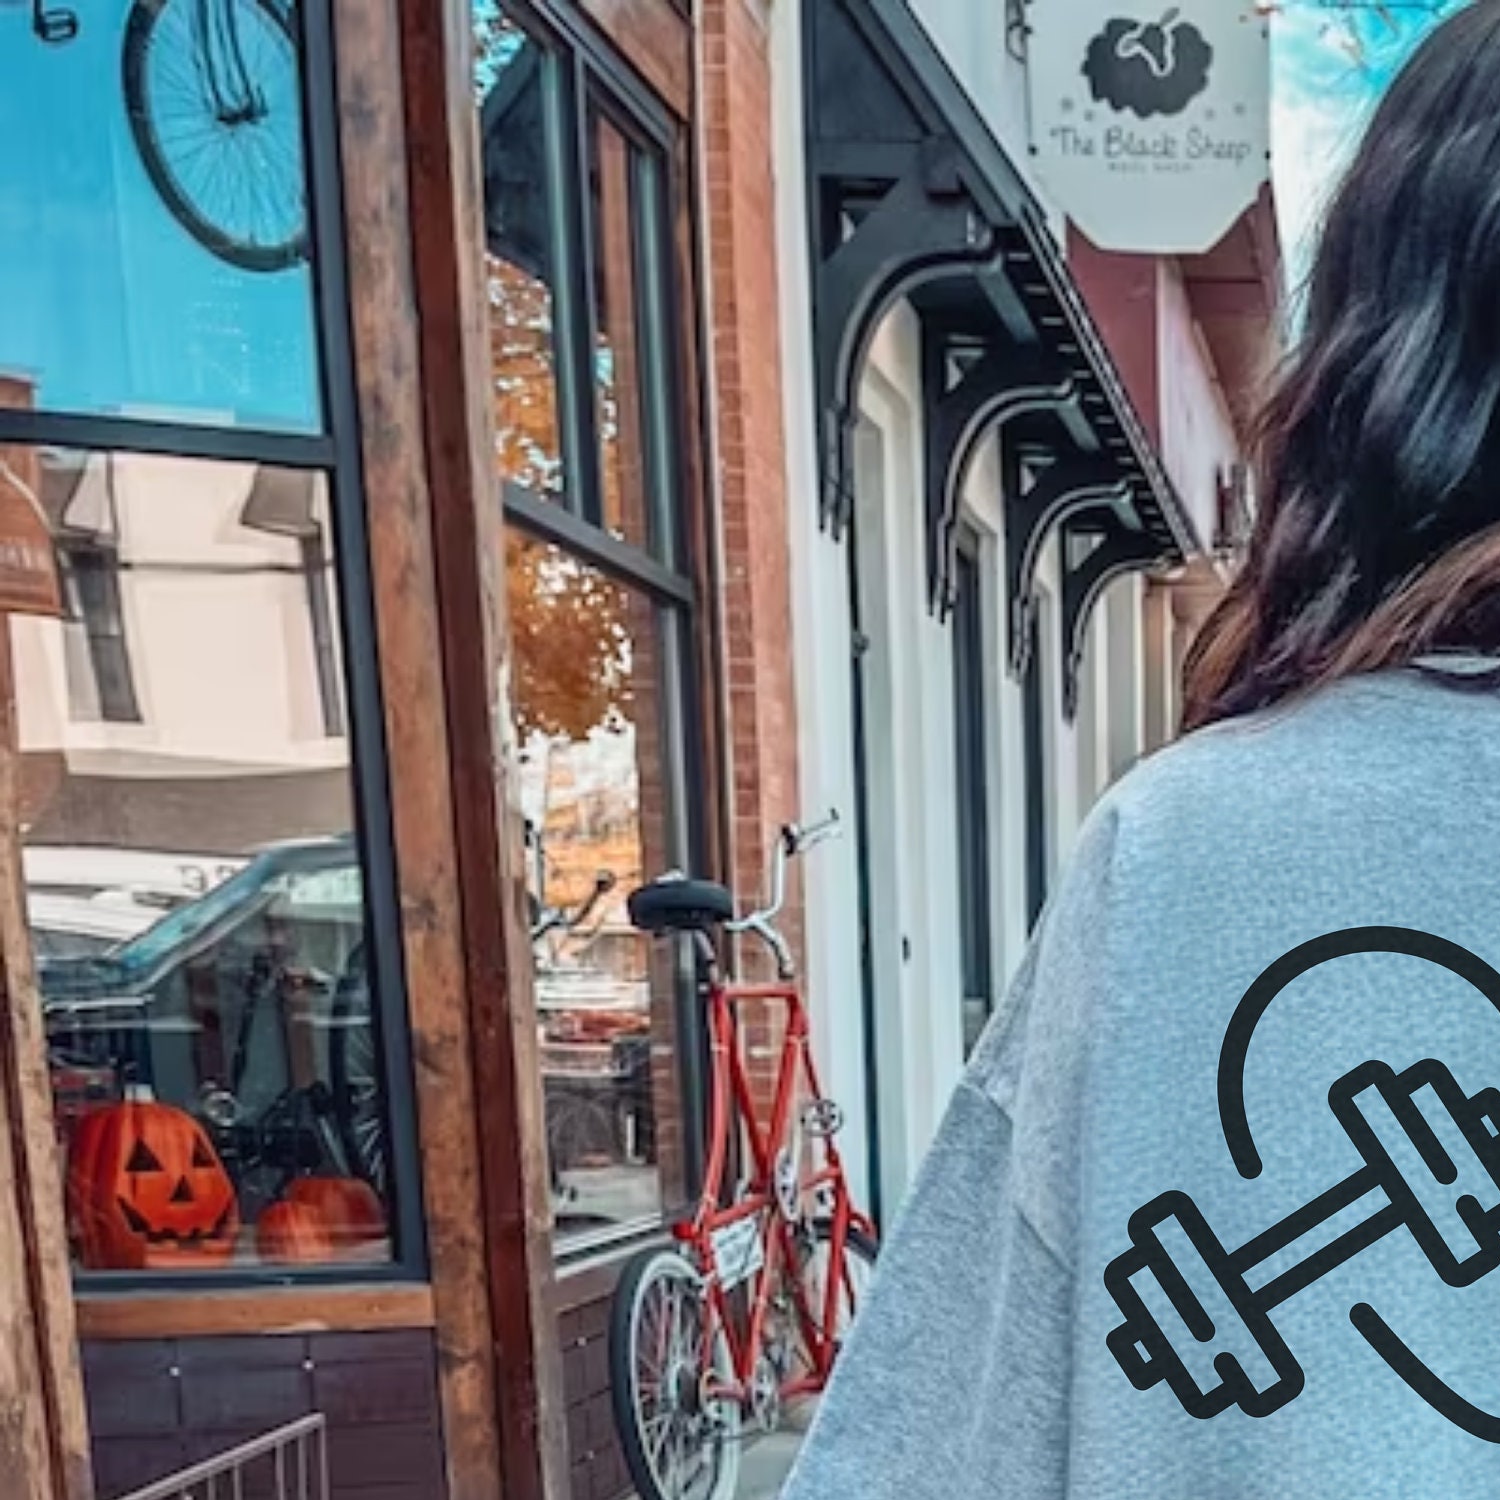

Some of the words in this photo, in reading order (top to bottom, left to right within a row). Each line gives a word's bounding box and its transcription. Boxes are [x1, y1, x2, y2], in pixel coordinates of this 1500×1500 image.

[1050, 127, 1095, 155] The
[1104, 125, 1178, 158] Black
[1186, 126, 1251, 166] Sheep
